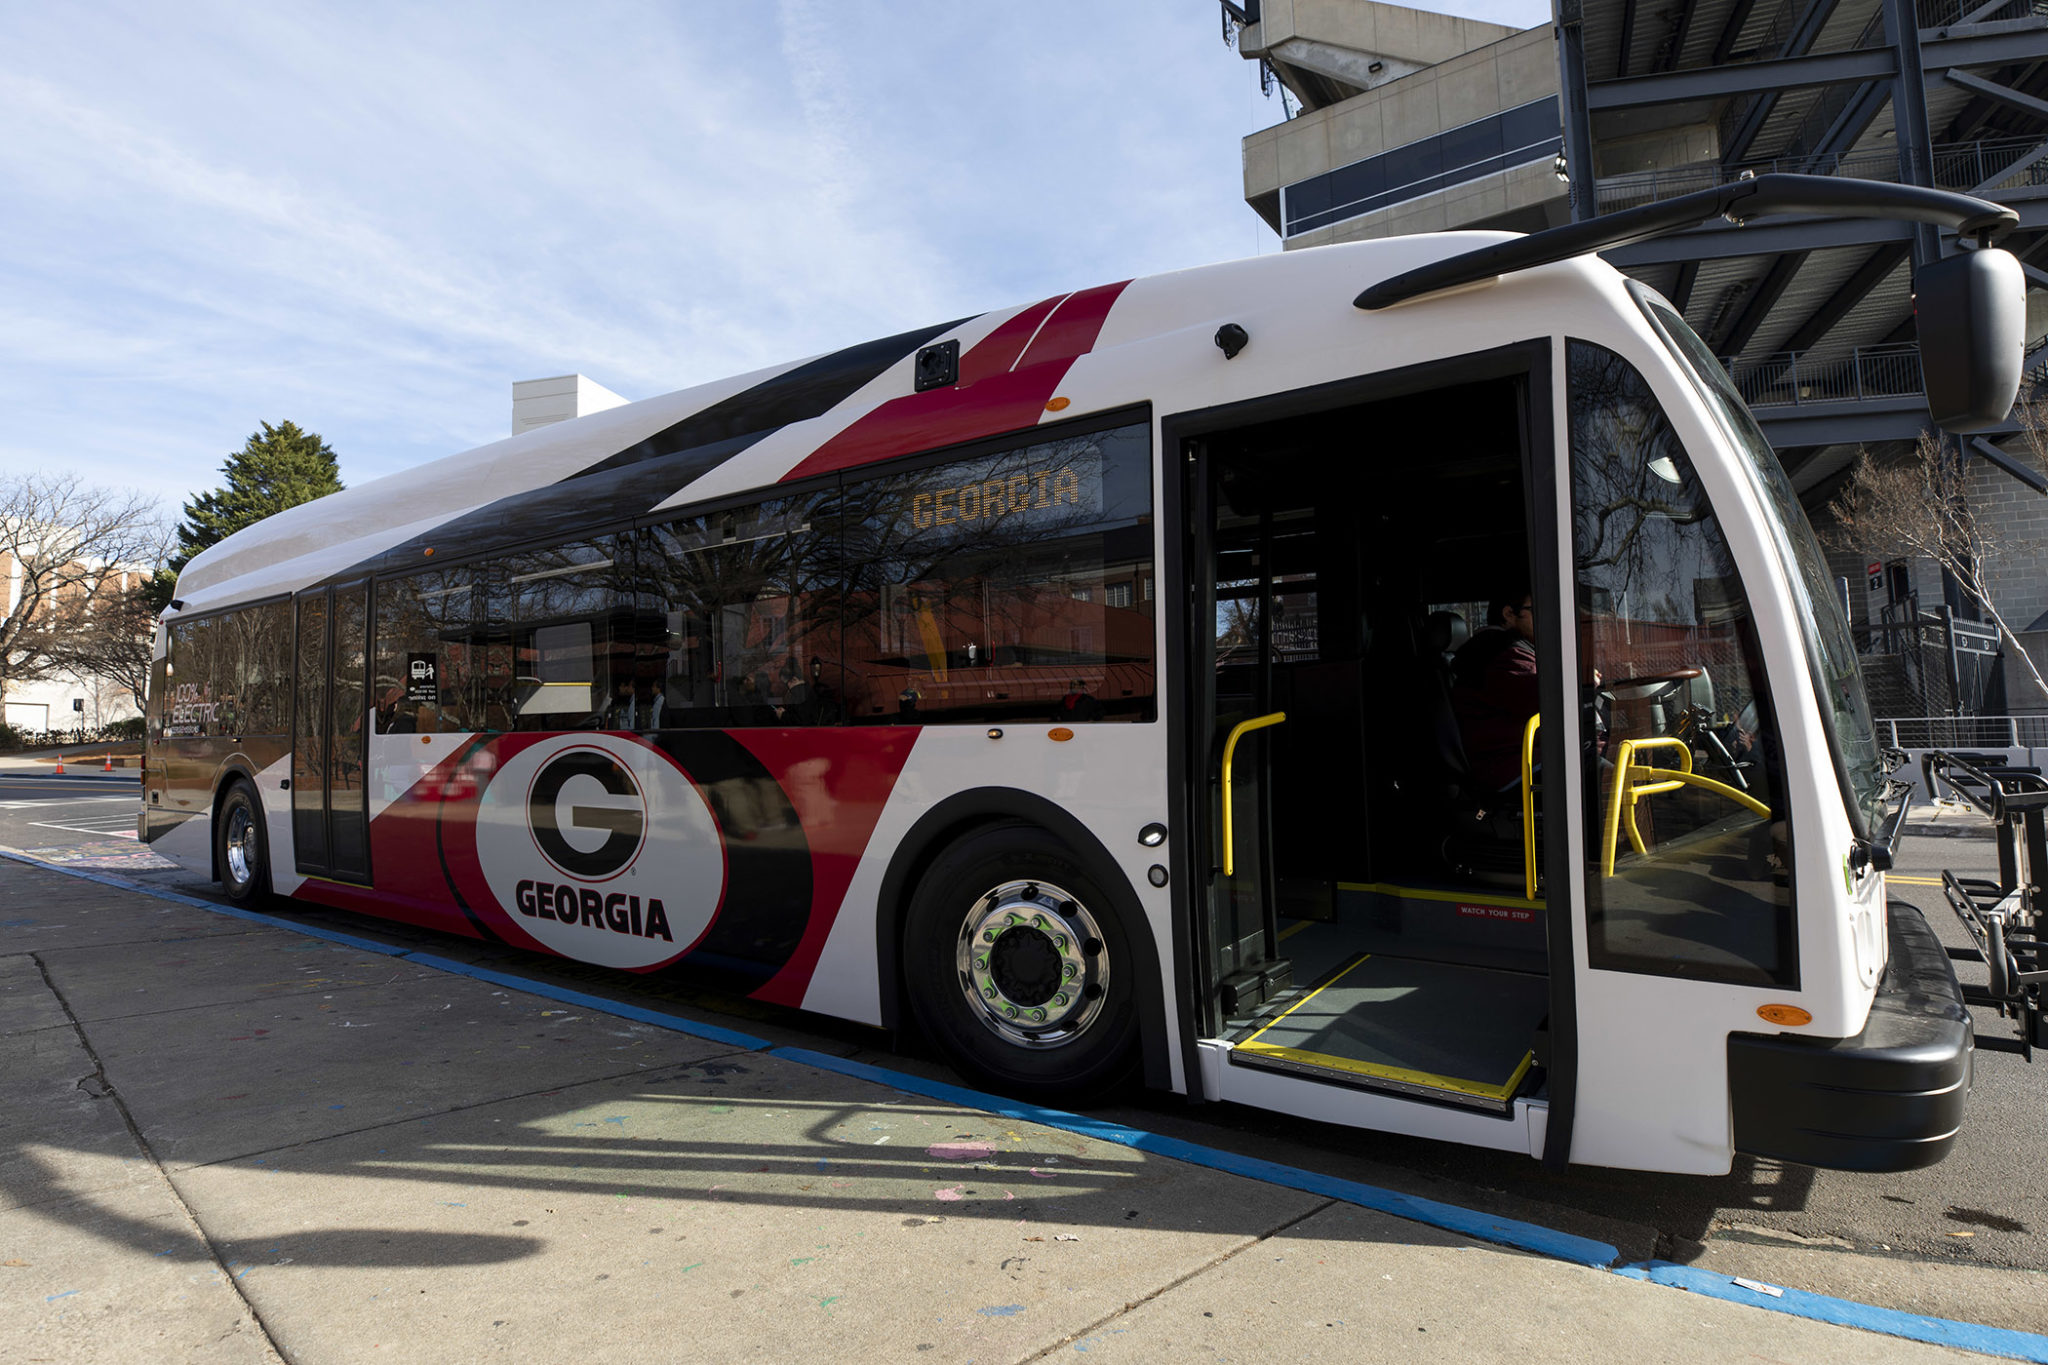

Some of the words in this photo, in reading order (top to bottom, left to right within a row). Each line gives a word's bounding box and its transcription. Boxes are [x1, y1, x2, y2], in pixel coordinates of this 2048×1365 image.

[913, 466, 1079, 529] GEORGIA
[172, 702, 220, 723] ELECTRIC
[176, 683, 199, 703] 100%
[530, 751, 643, 877] G
[515, 879, 674, 943] GEORGIA
[1461, 906, 1485, 915] WATCH
[1488, 909, 1508, 917] YOUR
[1511, 911, 1530, 919] STEP
